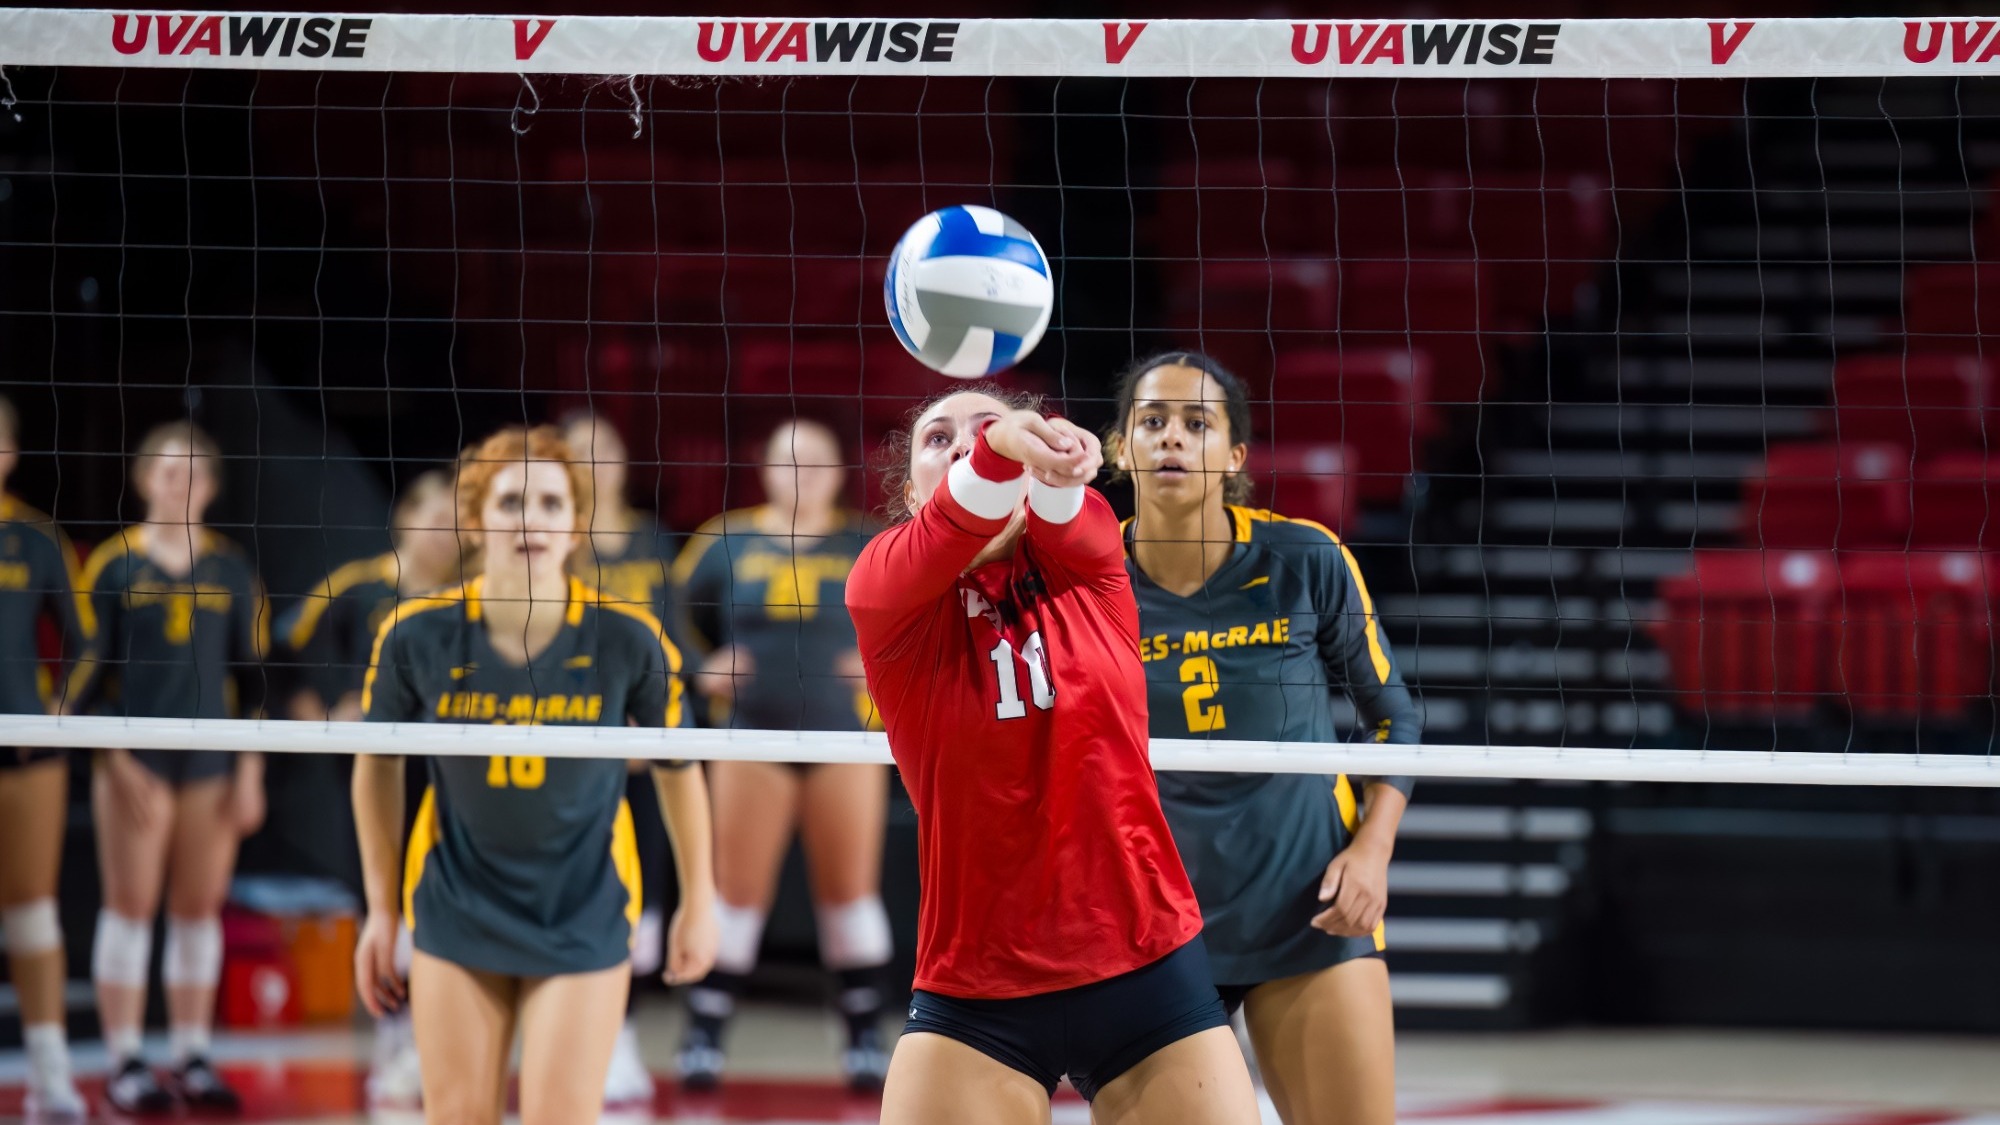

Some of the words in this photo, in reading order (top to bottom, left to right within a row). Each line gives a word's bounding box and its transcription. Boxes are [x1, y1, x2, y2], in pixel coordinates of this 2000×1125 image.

[111, 13, 371, 59] UVAWISE
[512, 19, 556, 61] V
[696, 21, 960, 63] UVAWISE
[1102, 22, 1147, 64] V
[1291, 23, 1561, 66] UVAWISE
[1707, 22, 1755, 65] V
[1139, 617, 1290, 663] ES-McRAE
[989, 630, 1057, 722] 10
[1178, 655, 1227, 734] 2
